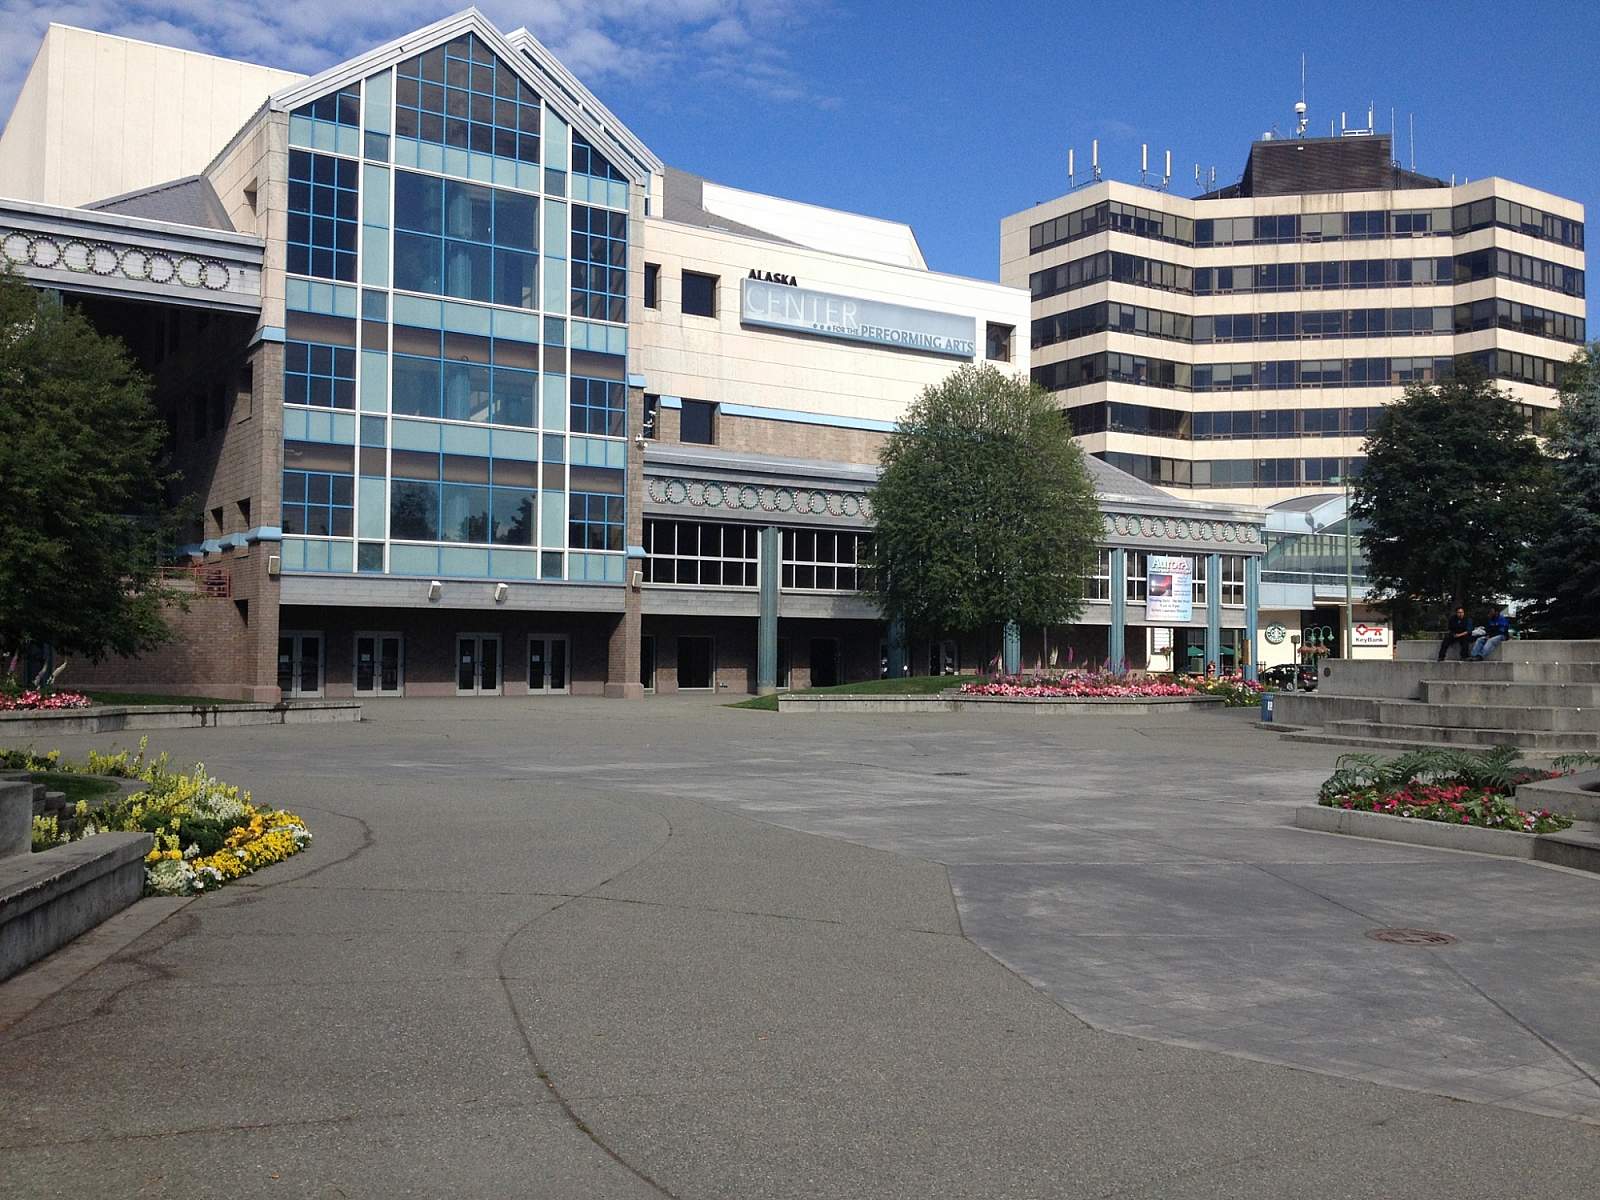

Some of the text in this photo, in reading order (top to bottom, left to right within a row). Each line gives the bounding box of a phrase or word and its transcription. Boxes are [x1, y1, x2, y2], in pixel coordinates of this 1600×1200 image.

[748, 268, 798, 287] ALASKA
[746, 287, 857, 327] CENTER
[832, 325, 974, 353] FOR THE PERFORMING ARTS
